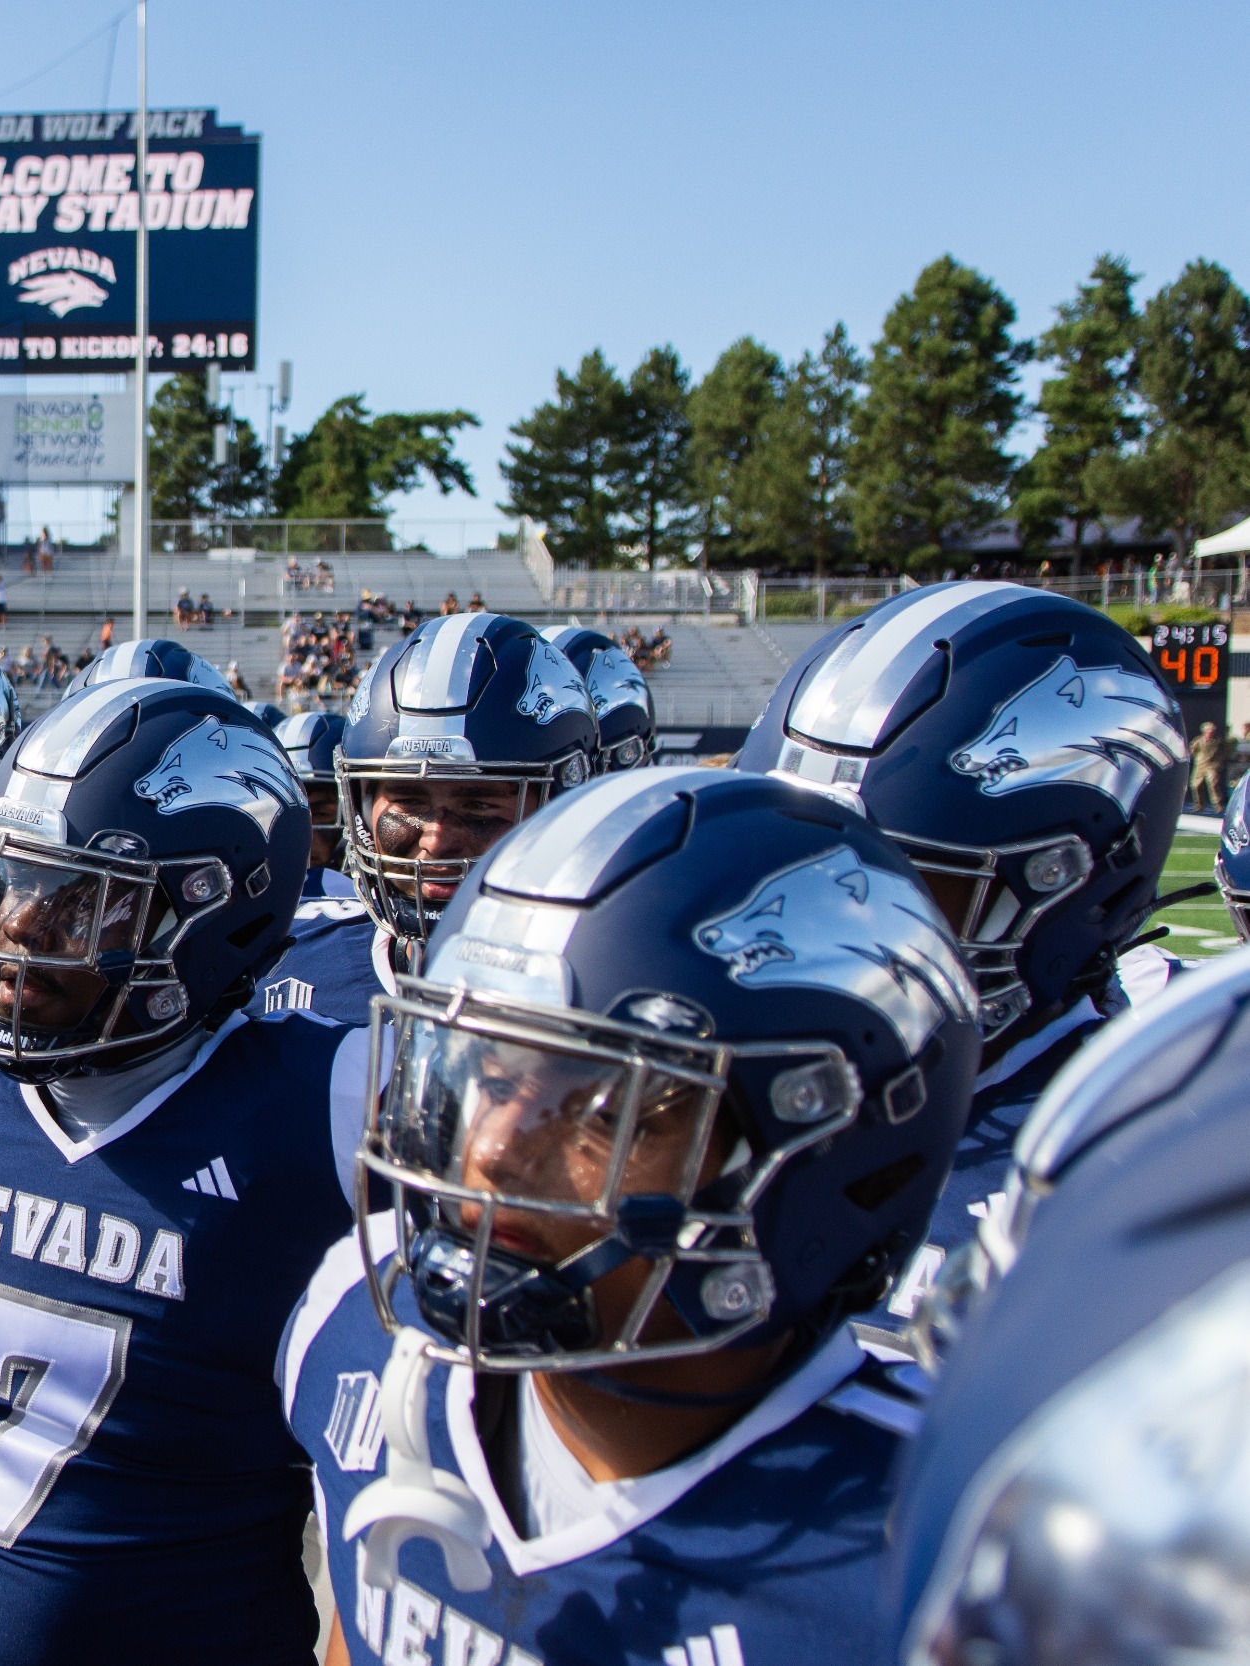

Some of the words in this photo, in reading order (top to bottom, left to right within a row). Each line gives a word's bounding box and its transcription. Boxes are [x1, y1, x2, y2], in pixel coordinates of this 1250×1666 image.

[41, 113, 127, 142] WOLF
[145, 151, 205, 193] TO
[52, 187, 255, 234] STADIUM
[7, 247, 117, 286] NEVADA
[22, 336, 56, 359] TO
[15, 401, 85, 417] NEVADA
[14, 416, 83, 433] DONOR
[14, 432, 104, 449] NETWORK
[1153, 624, 1228, 647] 24:15
[1161, 646, 1219, 685] 40
[401, 738, 453, 753] NEVADA
